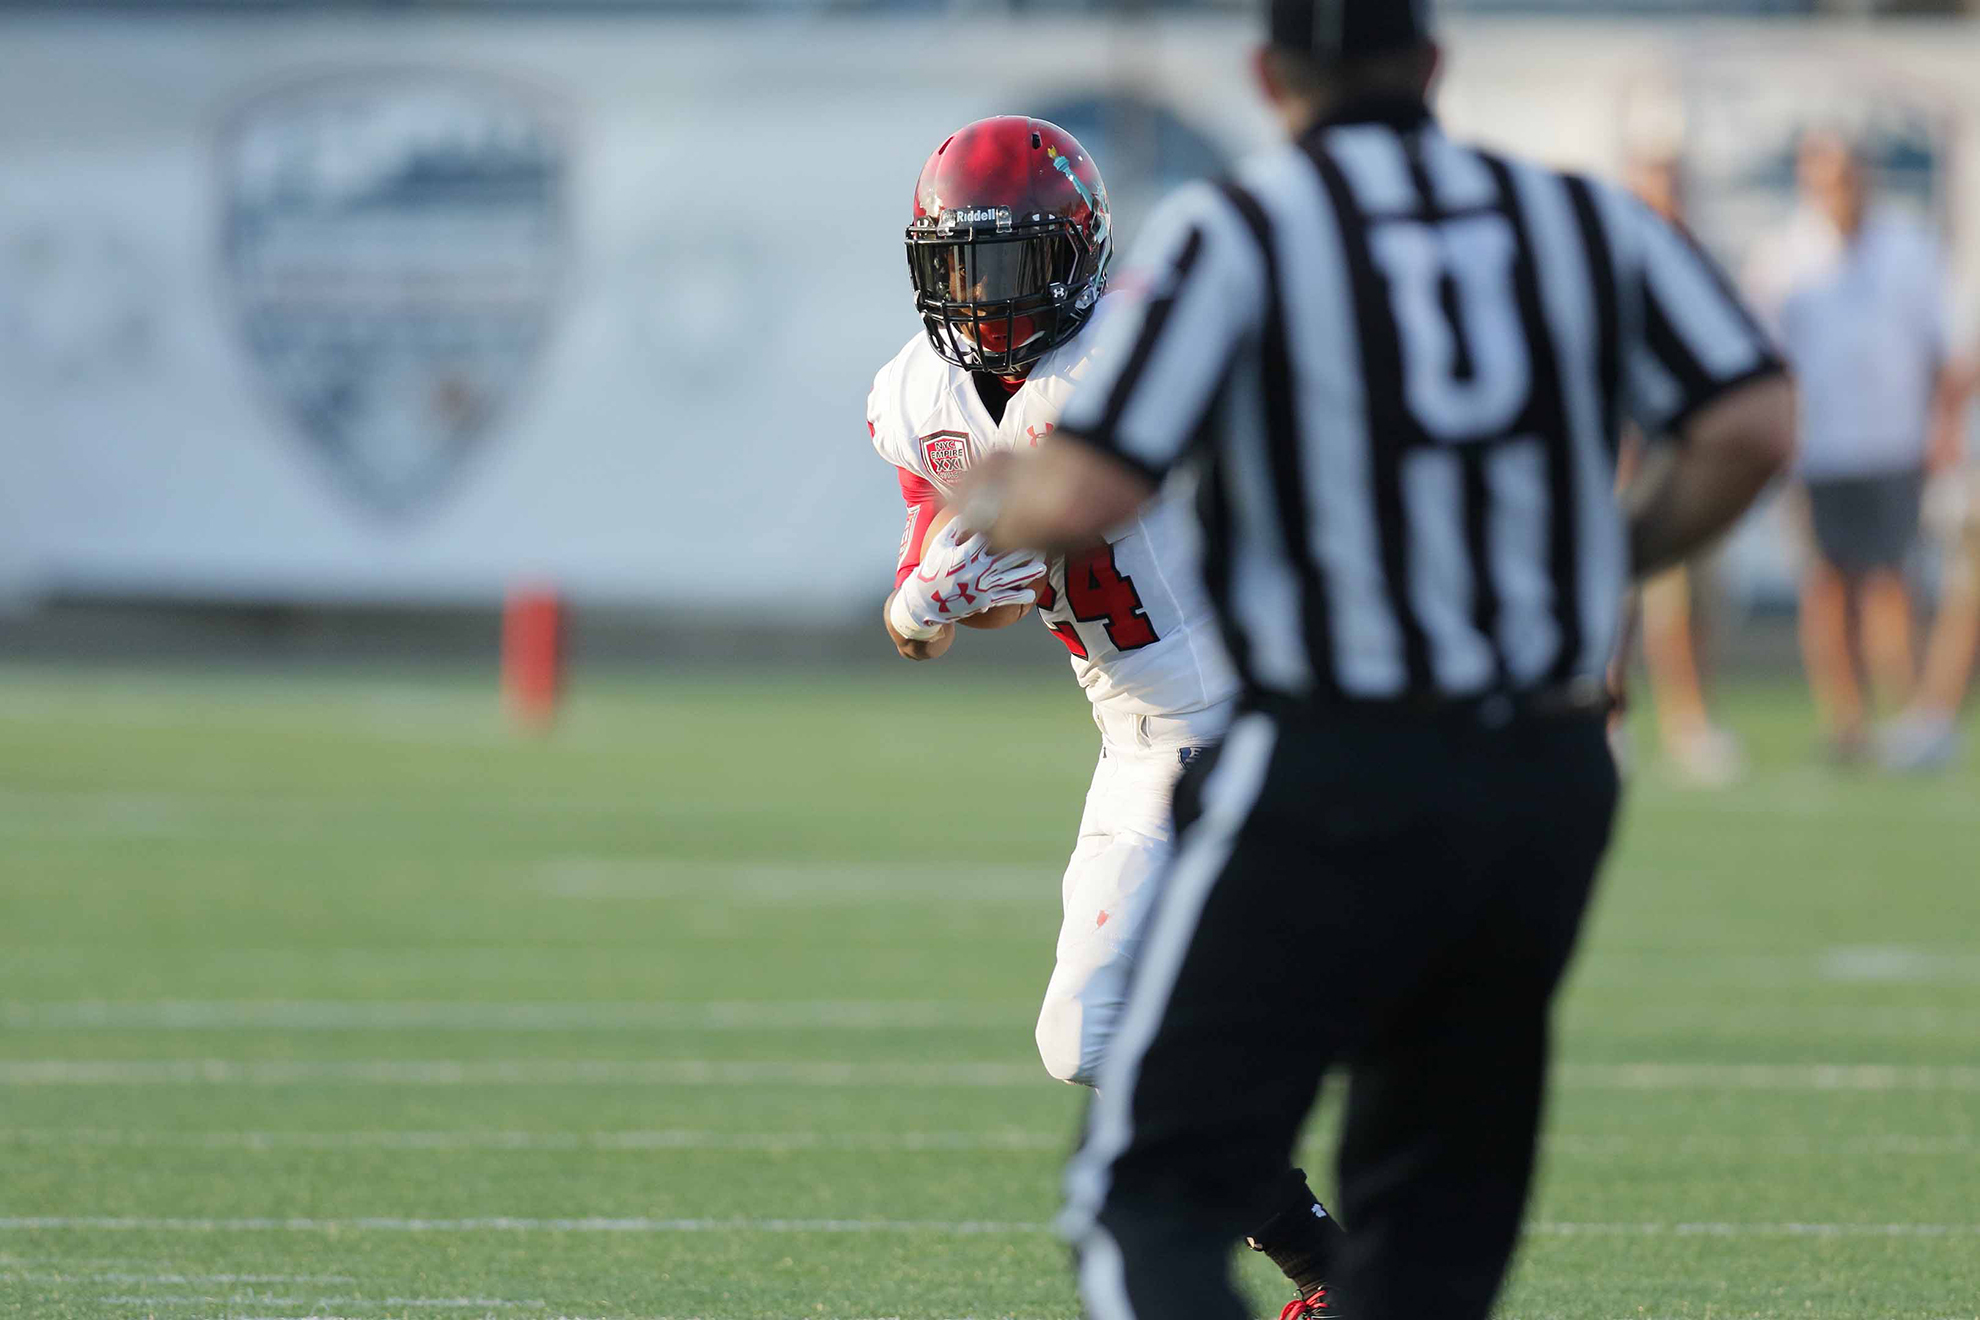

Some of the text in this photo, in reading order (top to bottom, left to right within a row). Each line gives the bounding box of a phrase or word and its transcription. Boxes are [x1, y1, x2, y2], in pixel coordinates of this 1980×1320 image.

[956, 208, 996, 223] Riddell
[1369, 214, 1532, 441] U
[935, 440, 956, 450] NYC
[931, 448, 963, 459] EMPIRE
[935, 458, 964, 471] XXI
